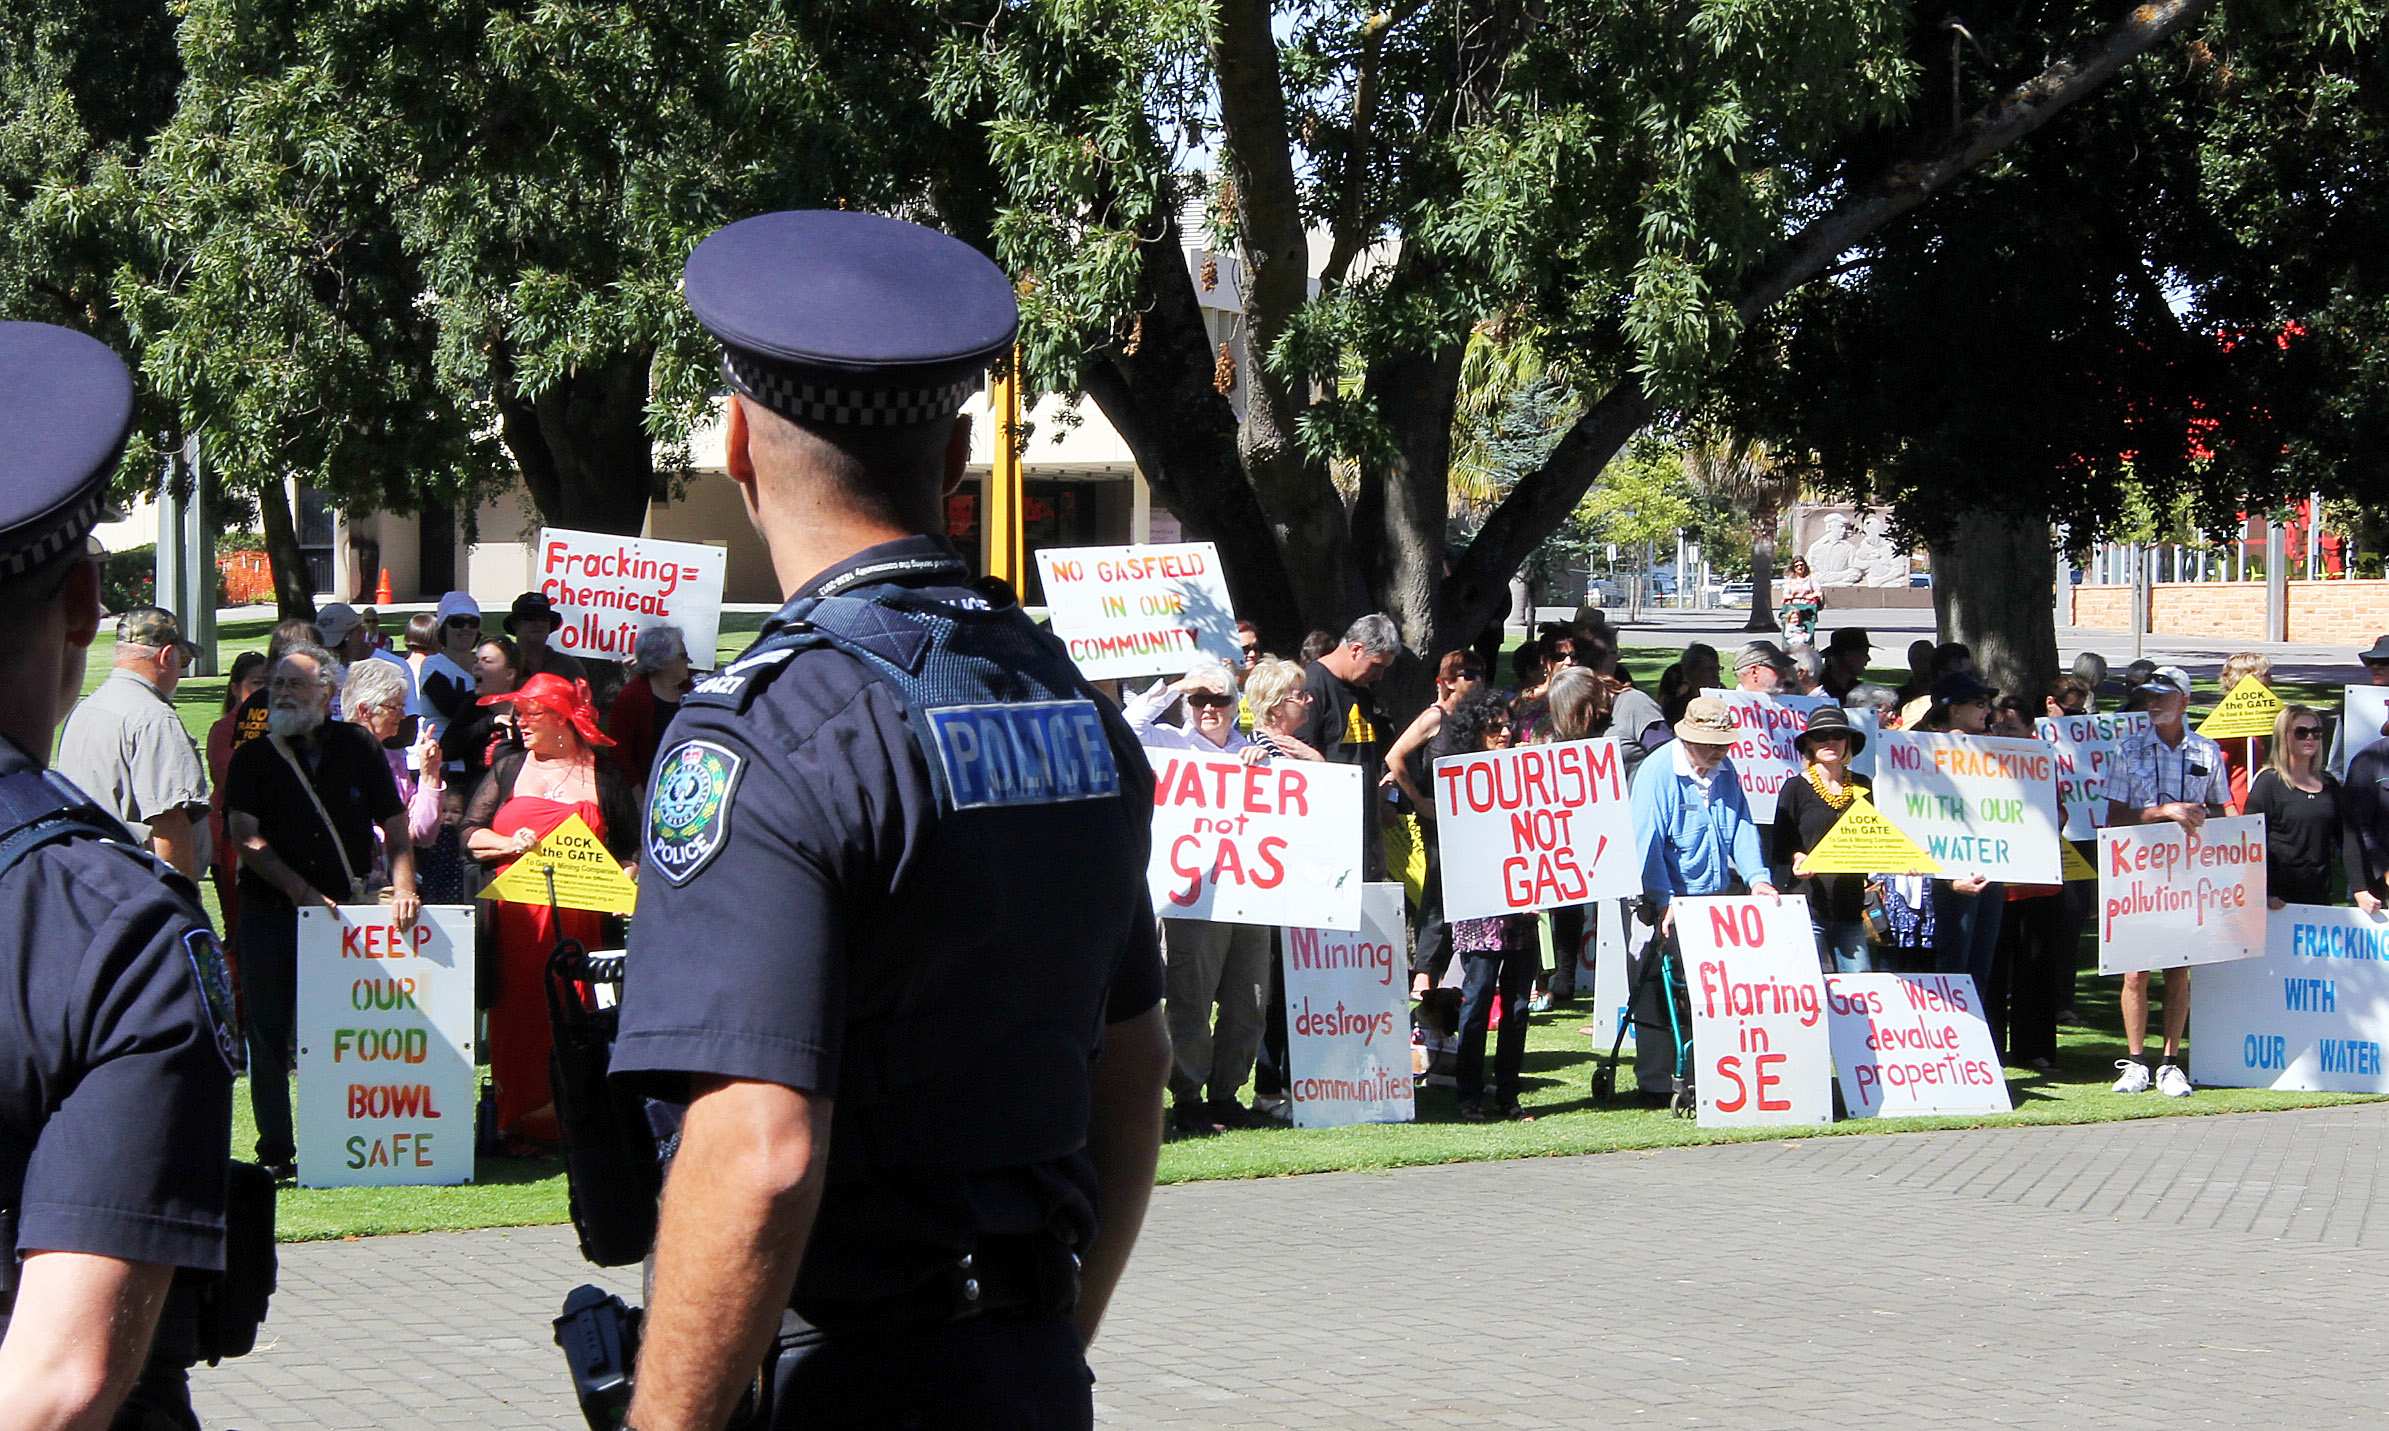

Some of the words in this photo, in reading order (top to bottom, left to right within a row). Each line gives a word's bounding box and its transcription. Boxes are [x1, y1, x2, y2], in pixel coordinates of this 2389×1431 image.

[1051, 560, 1084, 582] NO
[1097, 552, 1206, 583] GASFIELD
[541, 578, 670, 617] Chemical
[1101, 596, 1127, 618] IN
[1140, 593, 1186, 617] OUR
[560, 612, 639, 655] olluti
[1069, 627, 1199, 663] COMMUNITY
[2225, 702, 2243, 710] the
[2246, 699, 2276, 708] GATE
[2235, 691, 2266, 700] LOCK
[248, 708, 269, 721] NO
[1765, 707, 1809, 741] pois
[2069, 716, 2148, 742] GASFIE
[944, 709, 1110, 797] POLICE
[1890, 744, 1921, 771] NO
[1934, 749, 2050, 781] FRACKING
[1438, 742, 1620, 816] TOURISM
[1193, 813, 1250, 836] not
[1848, 815, 1879, 825] LOCK
[1904, 792, 1964, 823] WITH
[1980, 797, 2024, 825] OUR
[556, 835, 592, 849] LOCK
[653, 833, 711, 864] POLICE
[1510, 808, 1573, 854] NOT
[1840, 826, 1857, 835] the
[1860, 826, 1891, 835] GATE
[543, 848, 563, 859] the
[568, 849, 604, 863] GATE
[1927, 834, 2010, 865] WATER
[2111, 837, 2181, 882] Keep
[2185, 831, 2264, 870] Penola
[1168, 834, 1289, 908] GAS
[1708, 904, 1765, 948] NO
[2105, 880, 2193, 943] pollution
[2197, 877, 2246, 927] free
[341, 925, 433, 959] KEEP
[1289, 926, 1393, 986] Mining
[2293, 923, 2389, 961] FRACKING
[352, 977, 416, 1011] OUR
[1826, 978, 1884, 1016] Gas
[1899, 976, 1969, 1013] Wells
[2285, 977, 2336, 1013] WITH
[1295, 995, 1393, 1047] destroys
[1739, 1020, 1769, 1053] in
[1865, 1014, 1960, 1052] devalue
[334, 1028, 428, 1065] FOOD
[2243, 1034, 2286, 1070] OUR
[2320, 1038, 2381, 1075] WATER
[1293, 1066, 1413, 1103] communities
[1715, 1054, 1792, 1113] SE
[1855, 1053, 1994, 1107] properties
[347, 1083, 442, 1119] BOWL
[345, 1133, 434, 1170] SAFE
